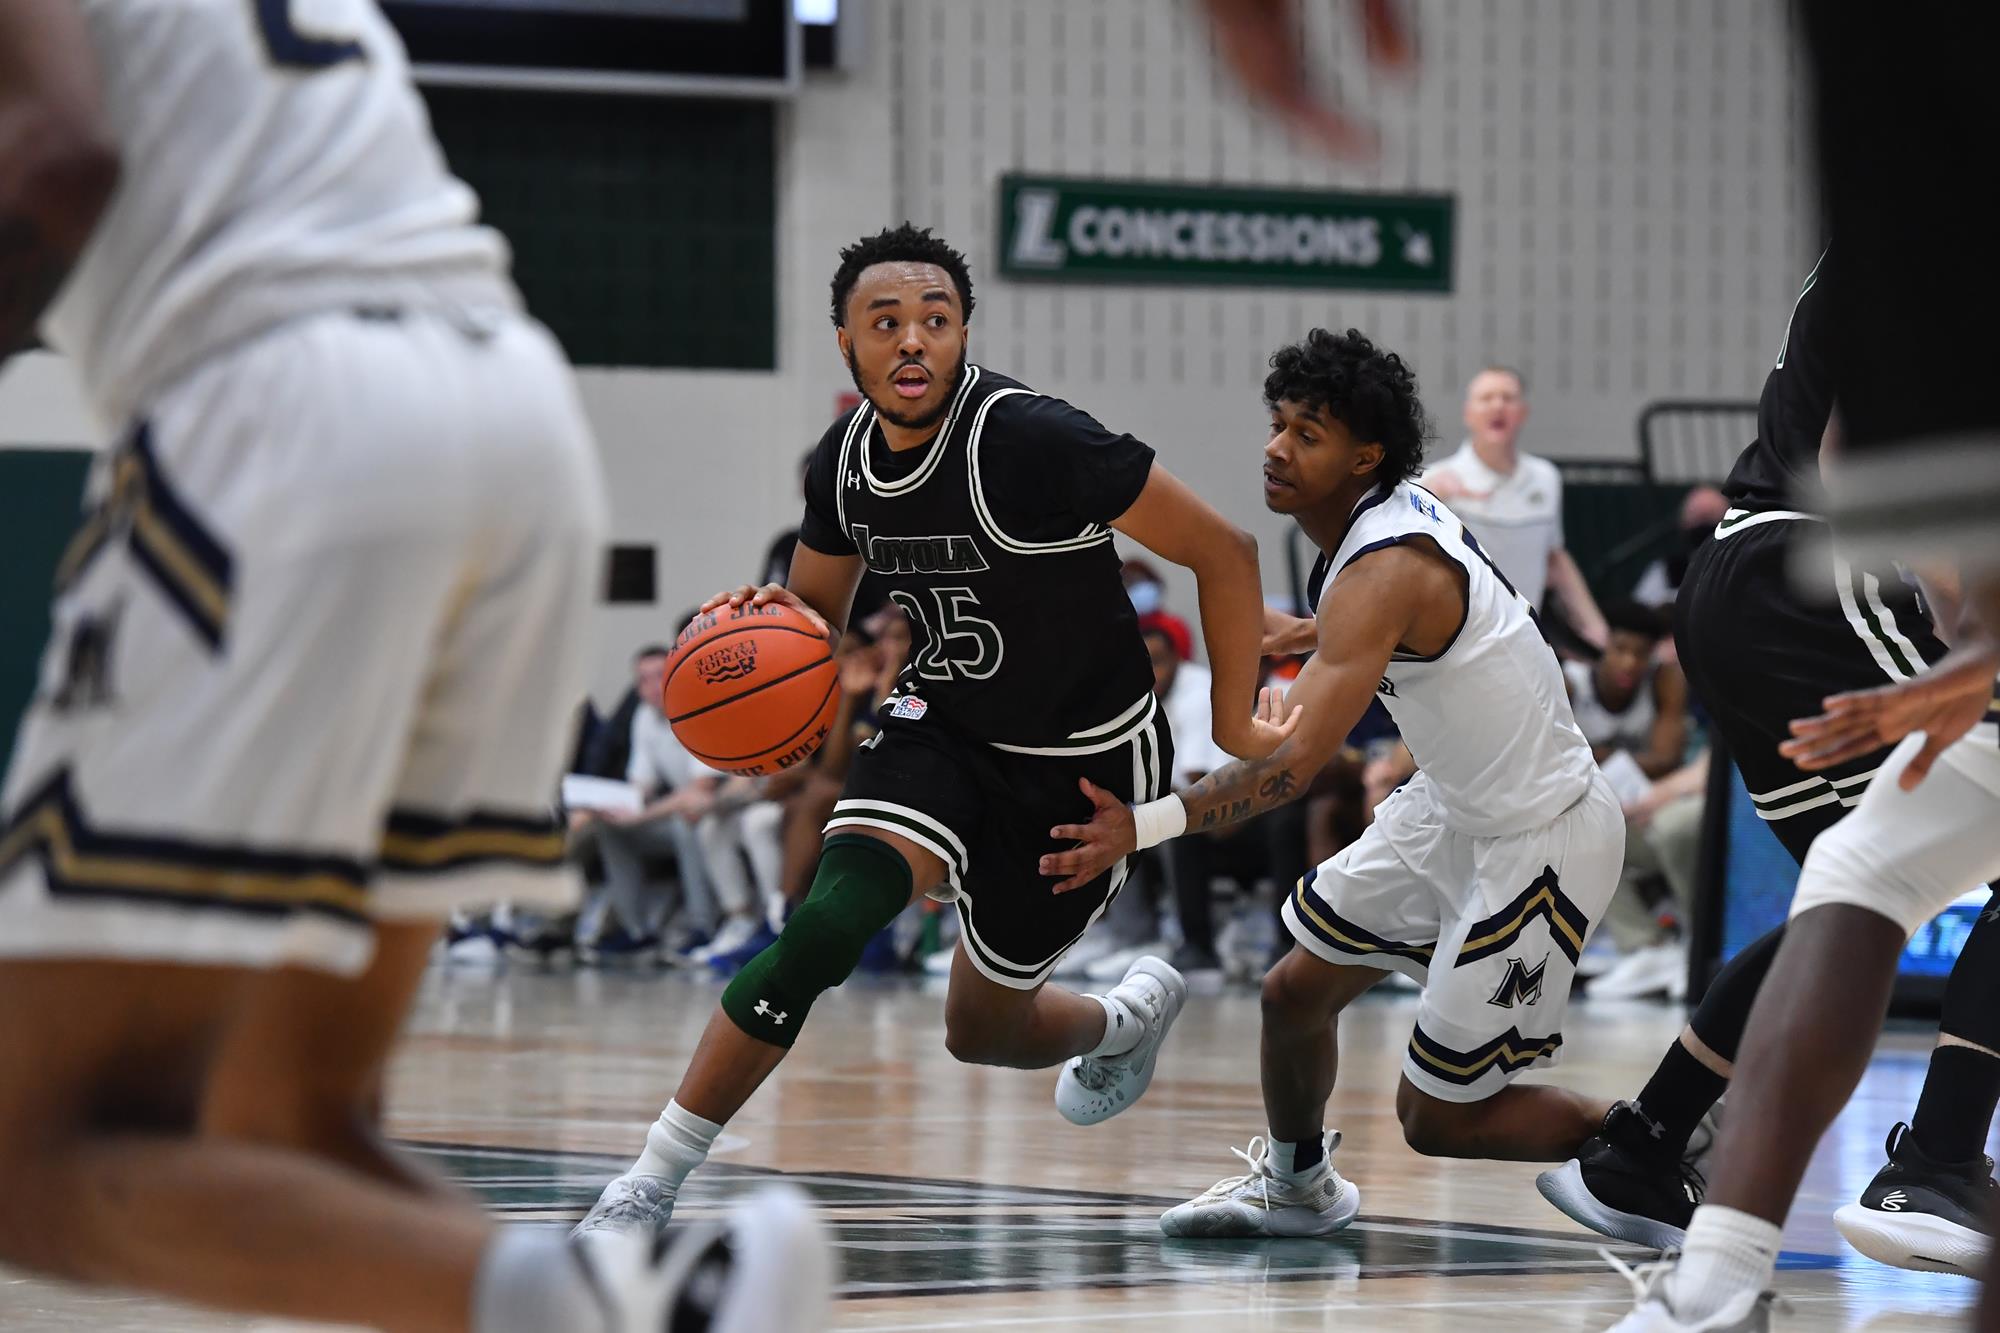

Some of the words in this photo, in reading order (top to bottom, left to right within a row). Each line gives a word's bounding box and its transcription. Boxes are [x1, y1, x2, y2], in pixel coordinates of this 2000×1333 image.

[1068, 206, 1382, 267] CONCESSIONS
[851, 523, 990, 575] LOYOLA
[889, 587, 1003, 680] 25
[695, 647, 758, 679] PATRIOT
